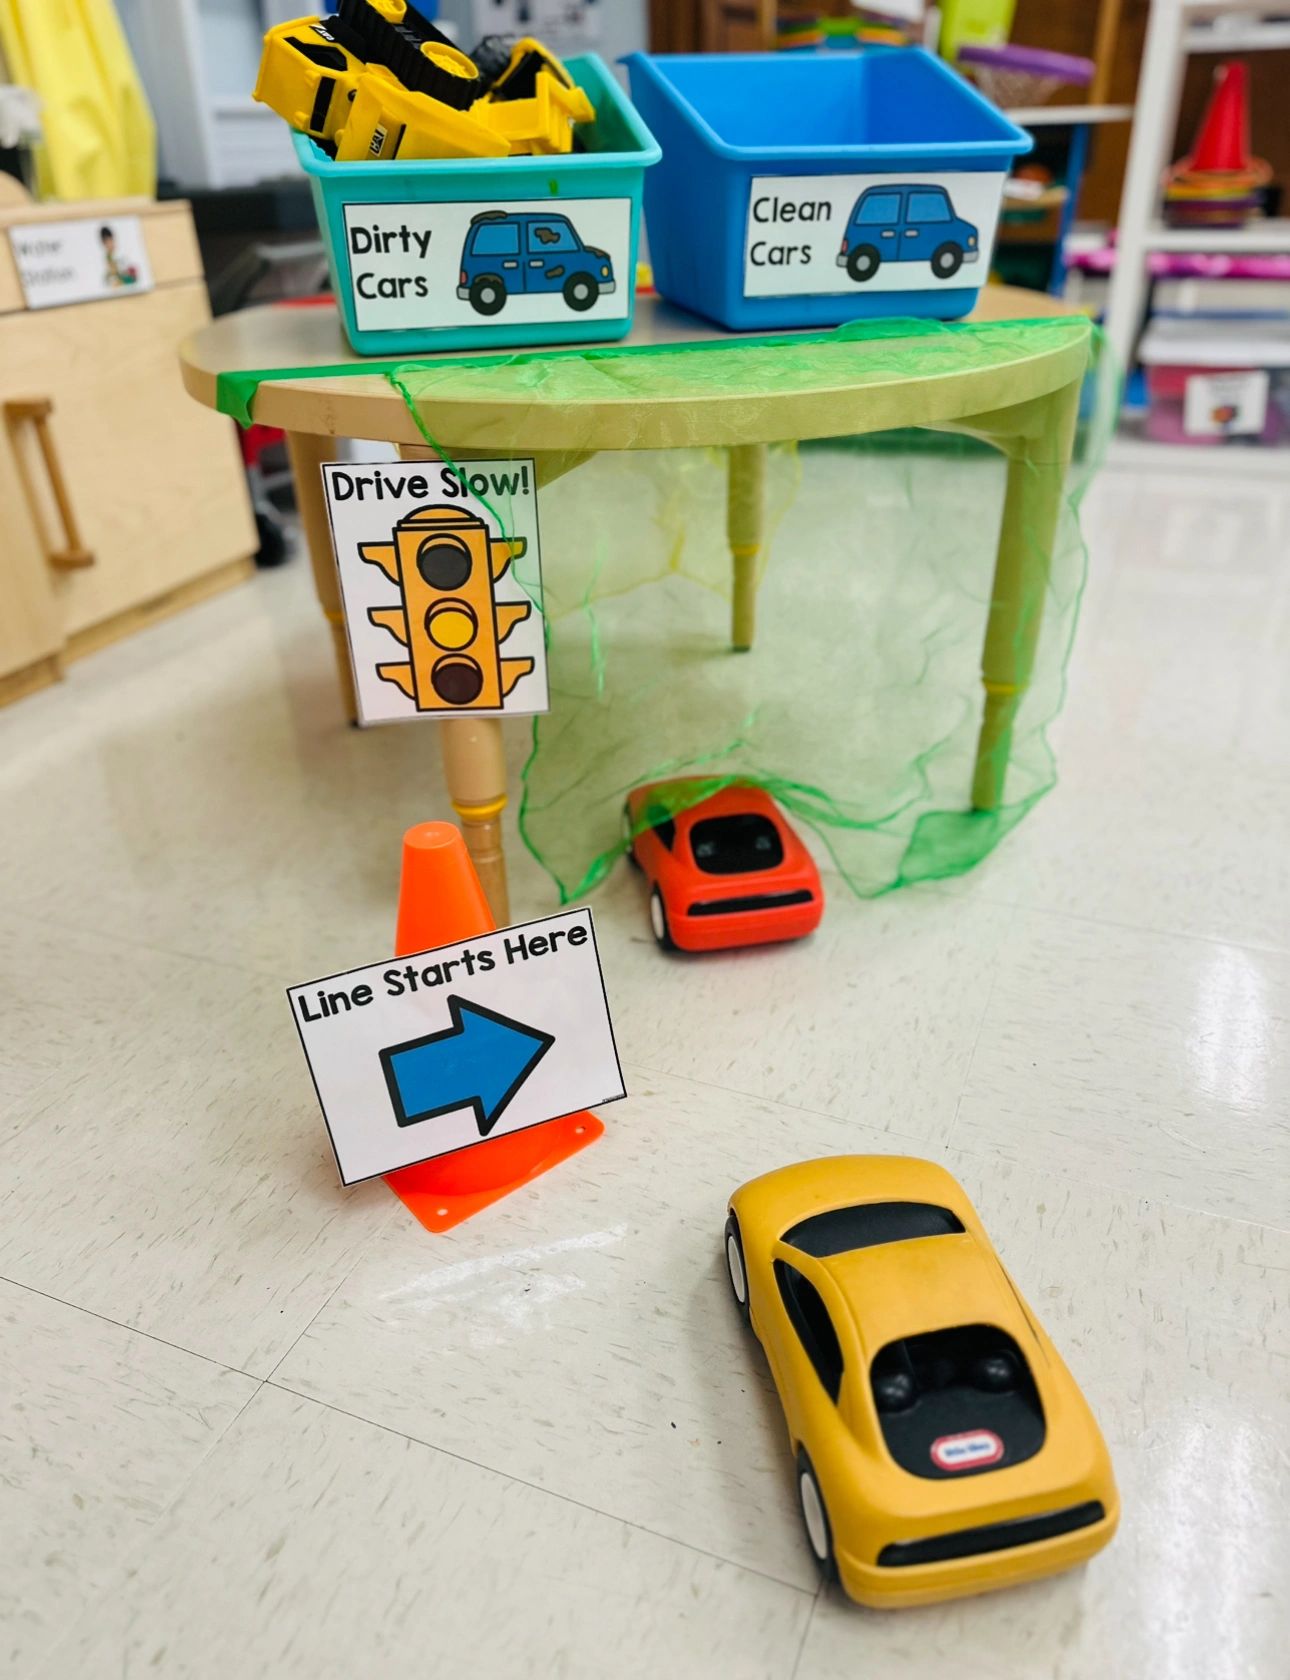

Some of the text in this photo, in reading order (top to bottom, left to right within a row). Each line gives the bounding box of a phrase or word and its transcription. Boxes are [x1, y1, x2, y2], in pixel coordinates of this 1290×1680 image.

[753, 196, 832, 223] Clean
[350, 224, 432, 259] Dirty
[750, 241, 812, 267] Cars
[356, 272, 429, 300] Cars
[332, 465, 530, 501] Drive Slow!
[297, 925, 588, 1023] Line Starts Here
